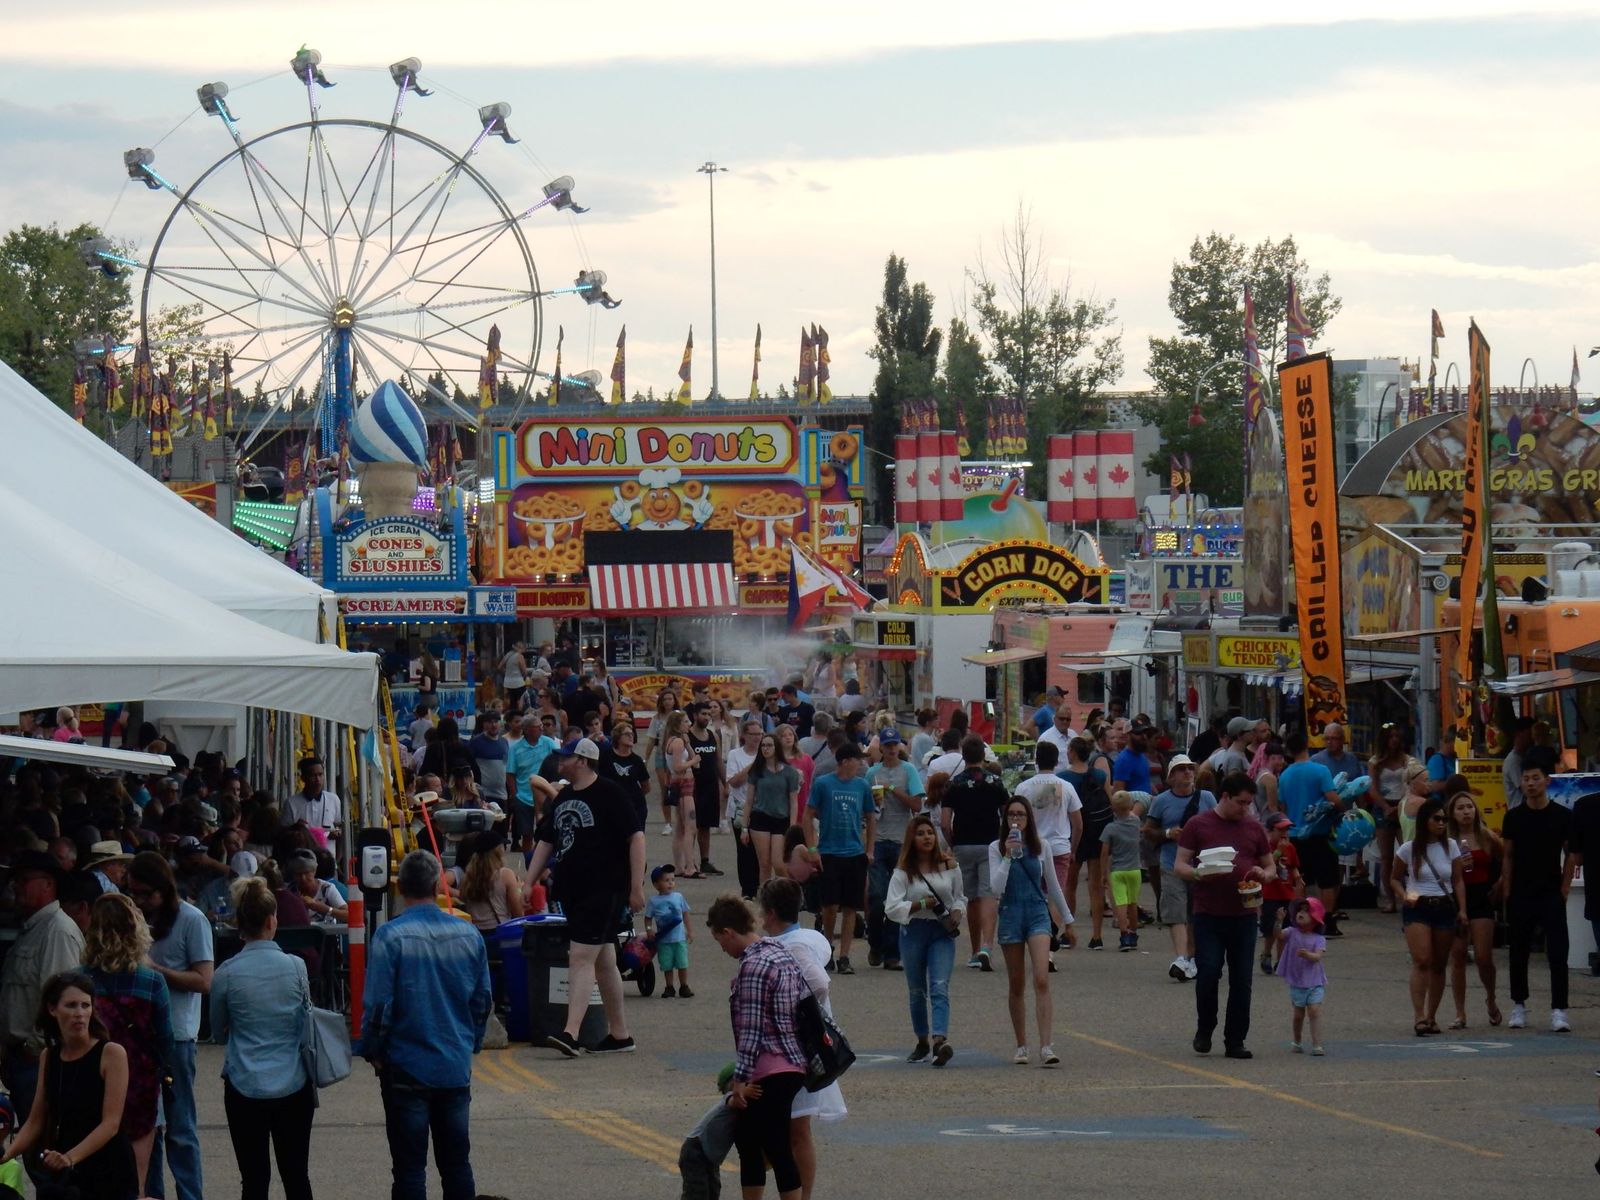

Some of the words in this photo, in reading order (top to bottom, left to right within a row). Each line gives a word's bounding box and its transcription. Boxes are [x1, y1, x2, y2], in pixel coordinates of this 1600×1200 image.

[539, 427, 627, 468] Mini
[637, 426, 777, 463] Donuts
[1406, 469, 1466, 491] MARD
[1490, 469, 1553, 491] GRAS
[1563, 469, 1600, 491] GR
[370, 526, 385, 536] ICE
[387, 525, 420, 536] CREAM
[368, 539, 423, 550] CONES
[1207, 540, 1237, 551] DUCK
[350, 559, 442, 573] SLUSHIES
[964, 554, 1026, 592] CORN
[1032, 555, 1079, 591] DOG
[1163, 565, 1233, 588] THE
[1222, 592, 1243, 602] BUR
[347, 600, 456, 612] SCREAMERS
[486, 603, 514, 612] WATE
[887, 622, 906, 633] COLD
[883, 634, 911, 645] DRINKS
[1234, 640, 1287, 653] CHICKEN
[1233, 653, 1273, 665] TENDE
[710, 674, 732, 683] HOT
